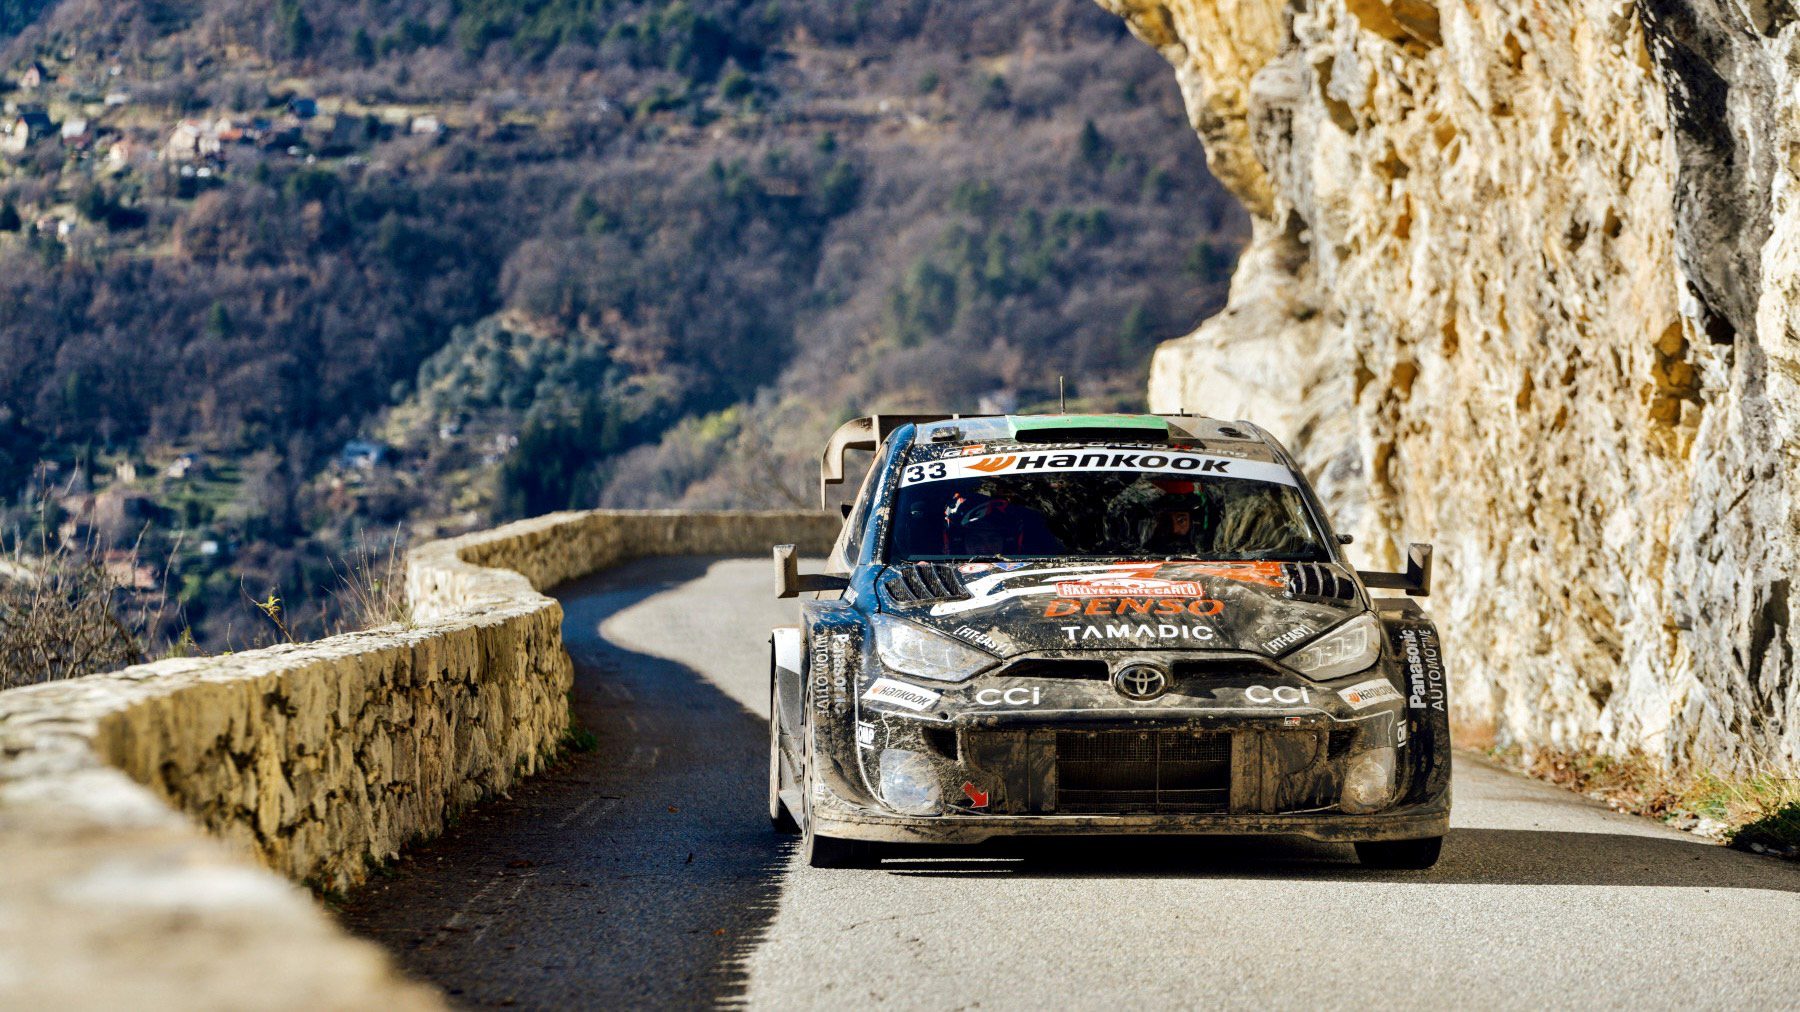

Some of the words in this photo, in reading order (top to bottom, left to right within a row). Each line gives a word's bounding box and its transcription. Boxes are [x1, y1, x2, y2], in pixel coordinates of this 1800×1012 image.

[907, 462, 947, 483] 33
[1062, 583, 1106, 596] RALLYE
[1044, 598, 1225, 617] DENSO
[1061, 624, 1213, 640] TAMADIC
[832, 633, 850, 715] Panasonic
[1400, 629, 1427, 709] Panasonic
[1419, 629, 1445, 712] AUTOMOTIVE
